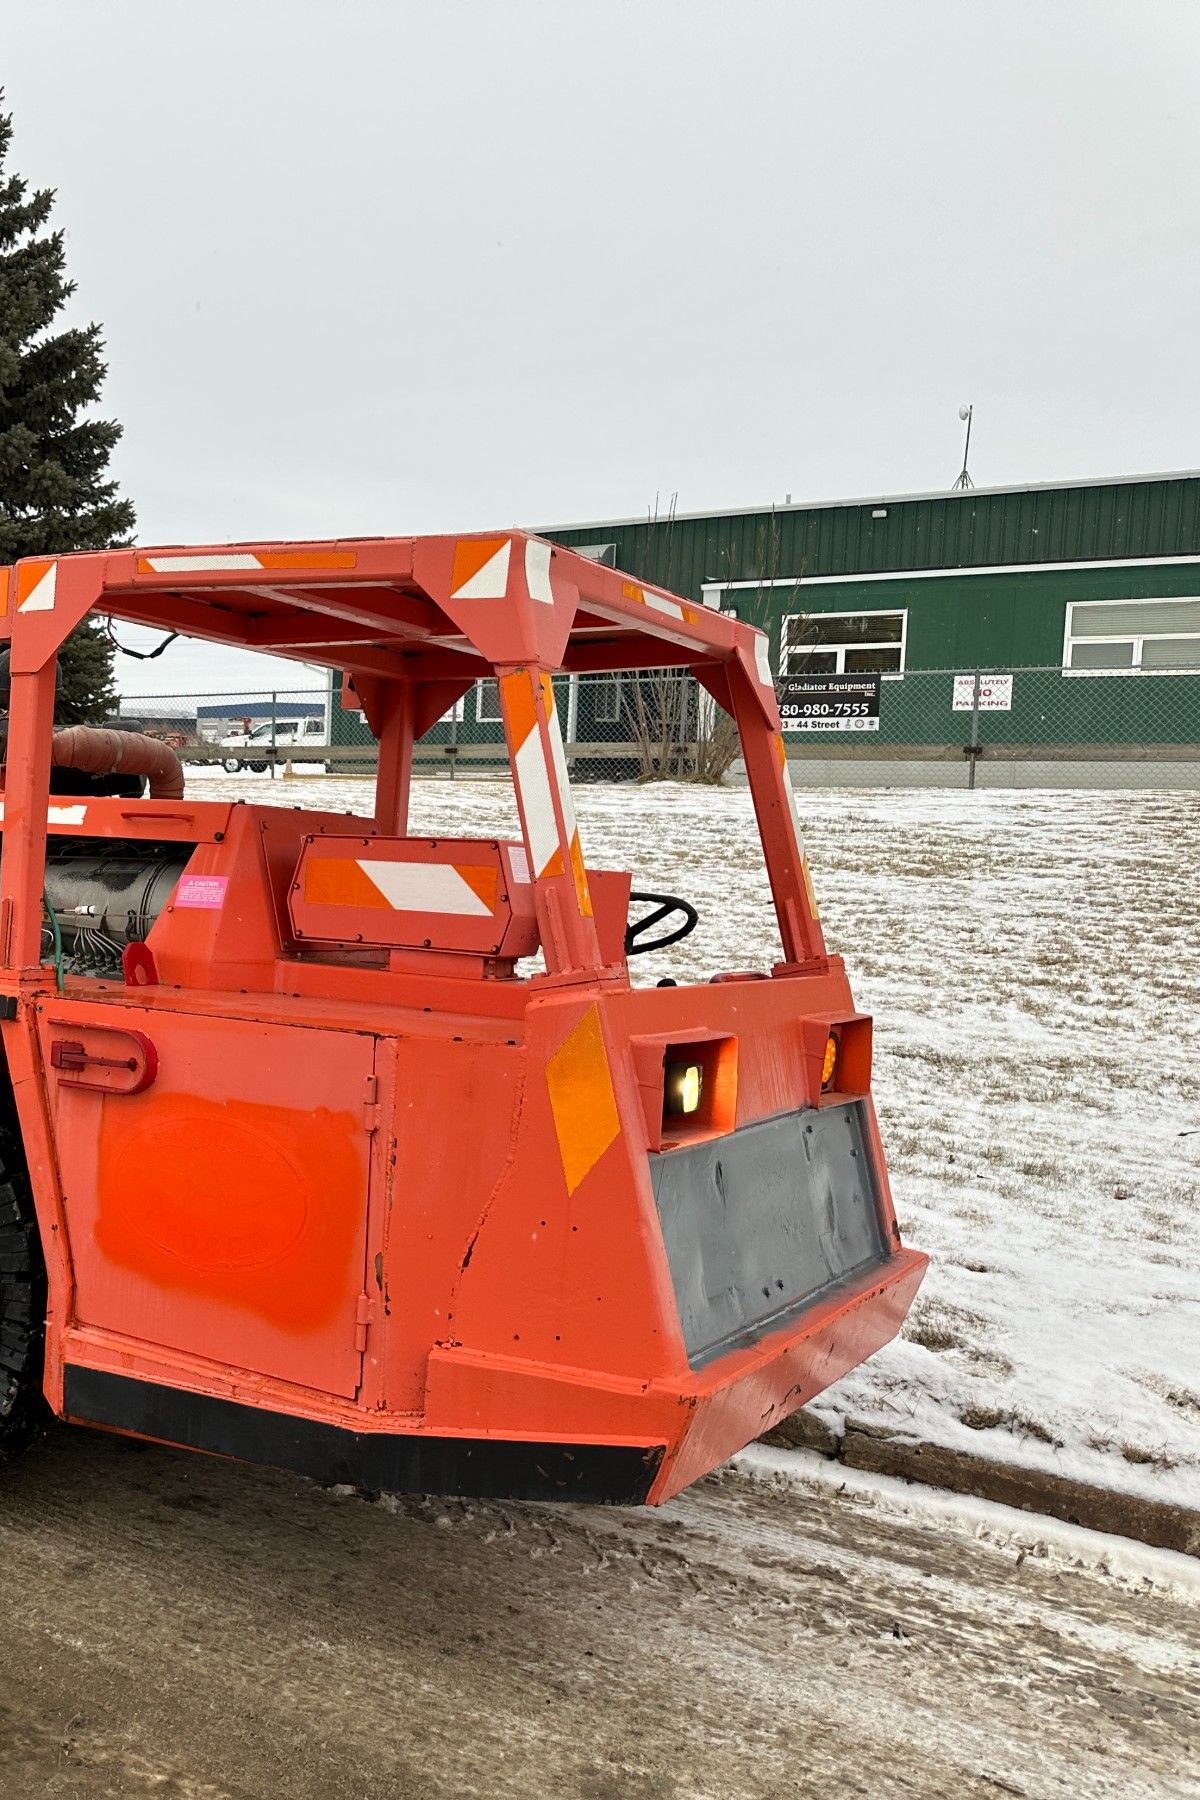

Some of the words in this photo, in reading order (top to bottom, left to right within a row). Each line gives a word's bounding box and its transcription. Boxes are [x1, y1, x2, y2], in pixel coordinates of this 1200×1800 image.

[788, 682, 826, 691] Gladiator
[828, 682, 876, 692] Equipment
[811, 720, 840, 729] Street
